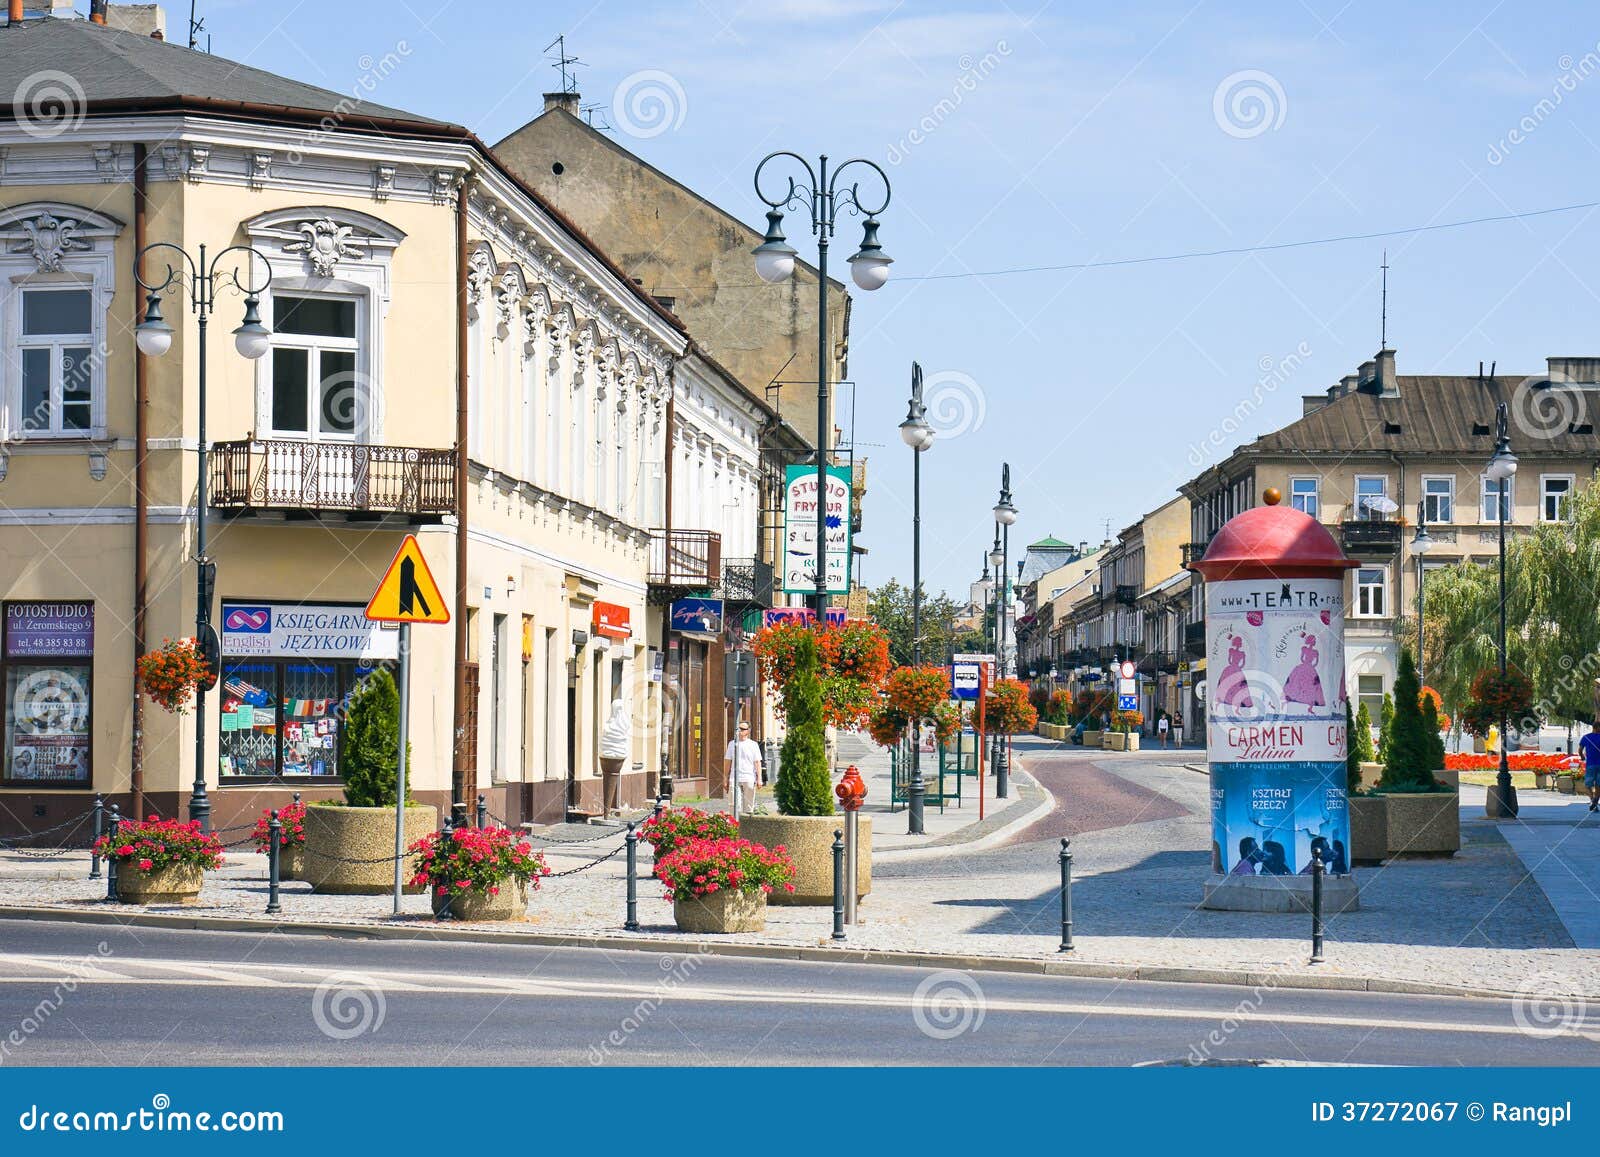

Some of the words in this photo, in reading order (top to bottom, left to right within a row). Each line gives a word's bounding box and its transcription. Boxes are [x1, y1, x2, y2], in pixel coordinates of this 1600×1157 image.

[793, 501, 842, 512] FRYUR
[7, 604, 88, 618] FOTOSTUDIO
[26, 618, 83, 632] Żeromskiego
[85, 620, 91, 630] 9
[274, 613, 378, 632] KSIĘGARNIA
[18, 638, 31, 647] tel.
[33, 638, 44, 647] 48
[45, 638, 61, 647] 385
[63, 638, 73, 647] 83
[75, 638, 87, 647] 88
[224, 635, 272, 649] English
[280, 634, 371, 653] JĘZYKOWA
[1228, 726, 1304, 748] CARMEN
[1235, 744, 1295, 760] Latina
[1252, 788, 1292, 798] KSZTAŁT
[1252, 800, 1288, 810] RZECZY
